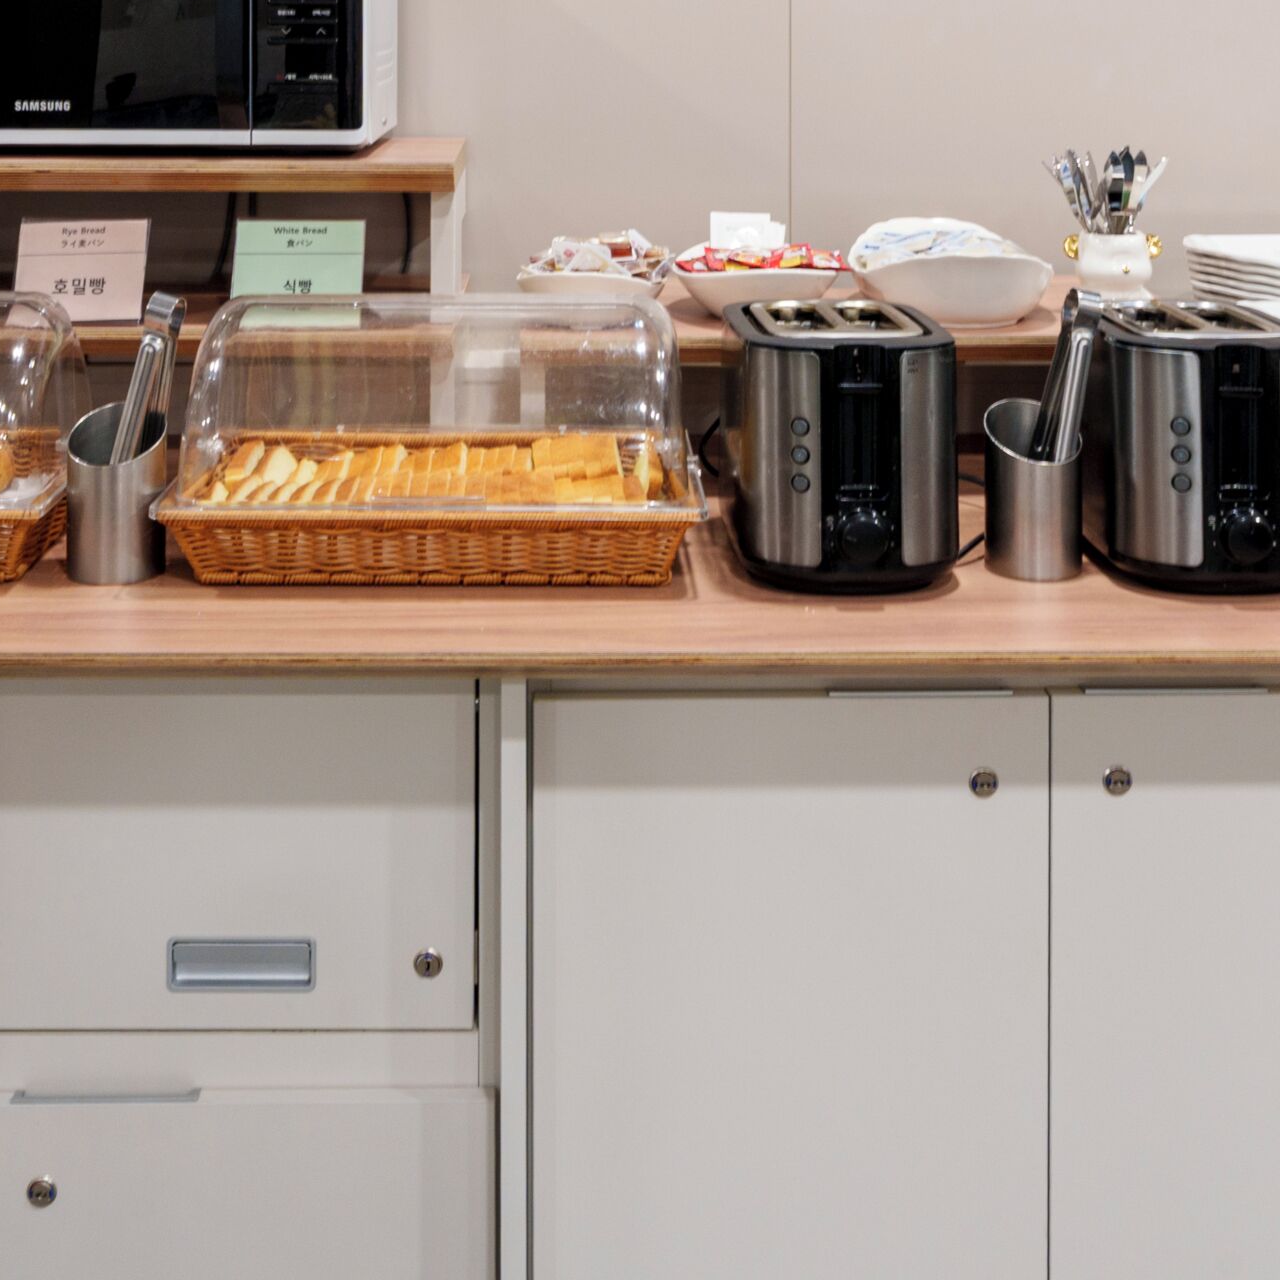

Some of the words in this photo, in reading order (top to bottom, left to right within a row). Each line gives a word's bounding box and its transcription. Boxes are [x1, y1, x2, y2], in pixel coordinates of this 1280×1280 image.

[14, 100, 71, 112] SAMSUNG
[62, 227, 78, 236] Rye
[81, 226, 106, 235] Bread
[273, 227, 300, 235] White
[302, 227, 328, 235] Bread
[286, 239, 313, 248] 食パン
[52, 276, 107, 296] 호밀빵
[283, 278, 313, 295] 식빵
